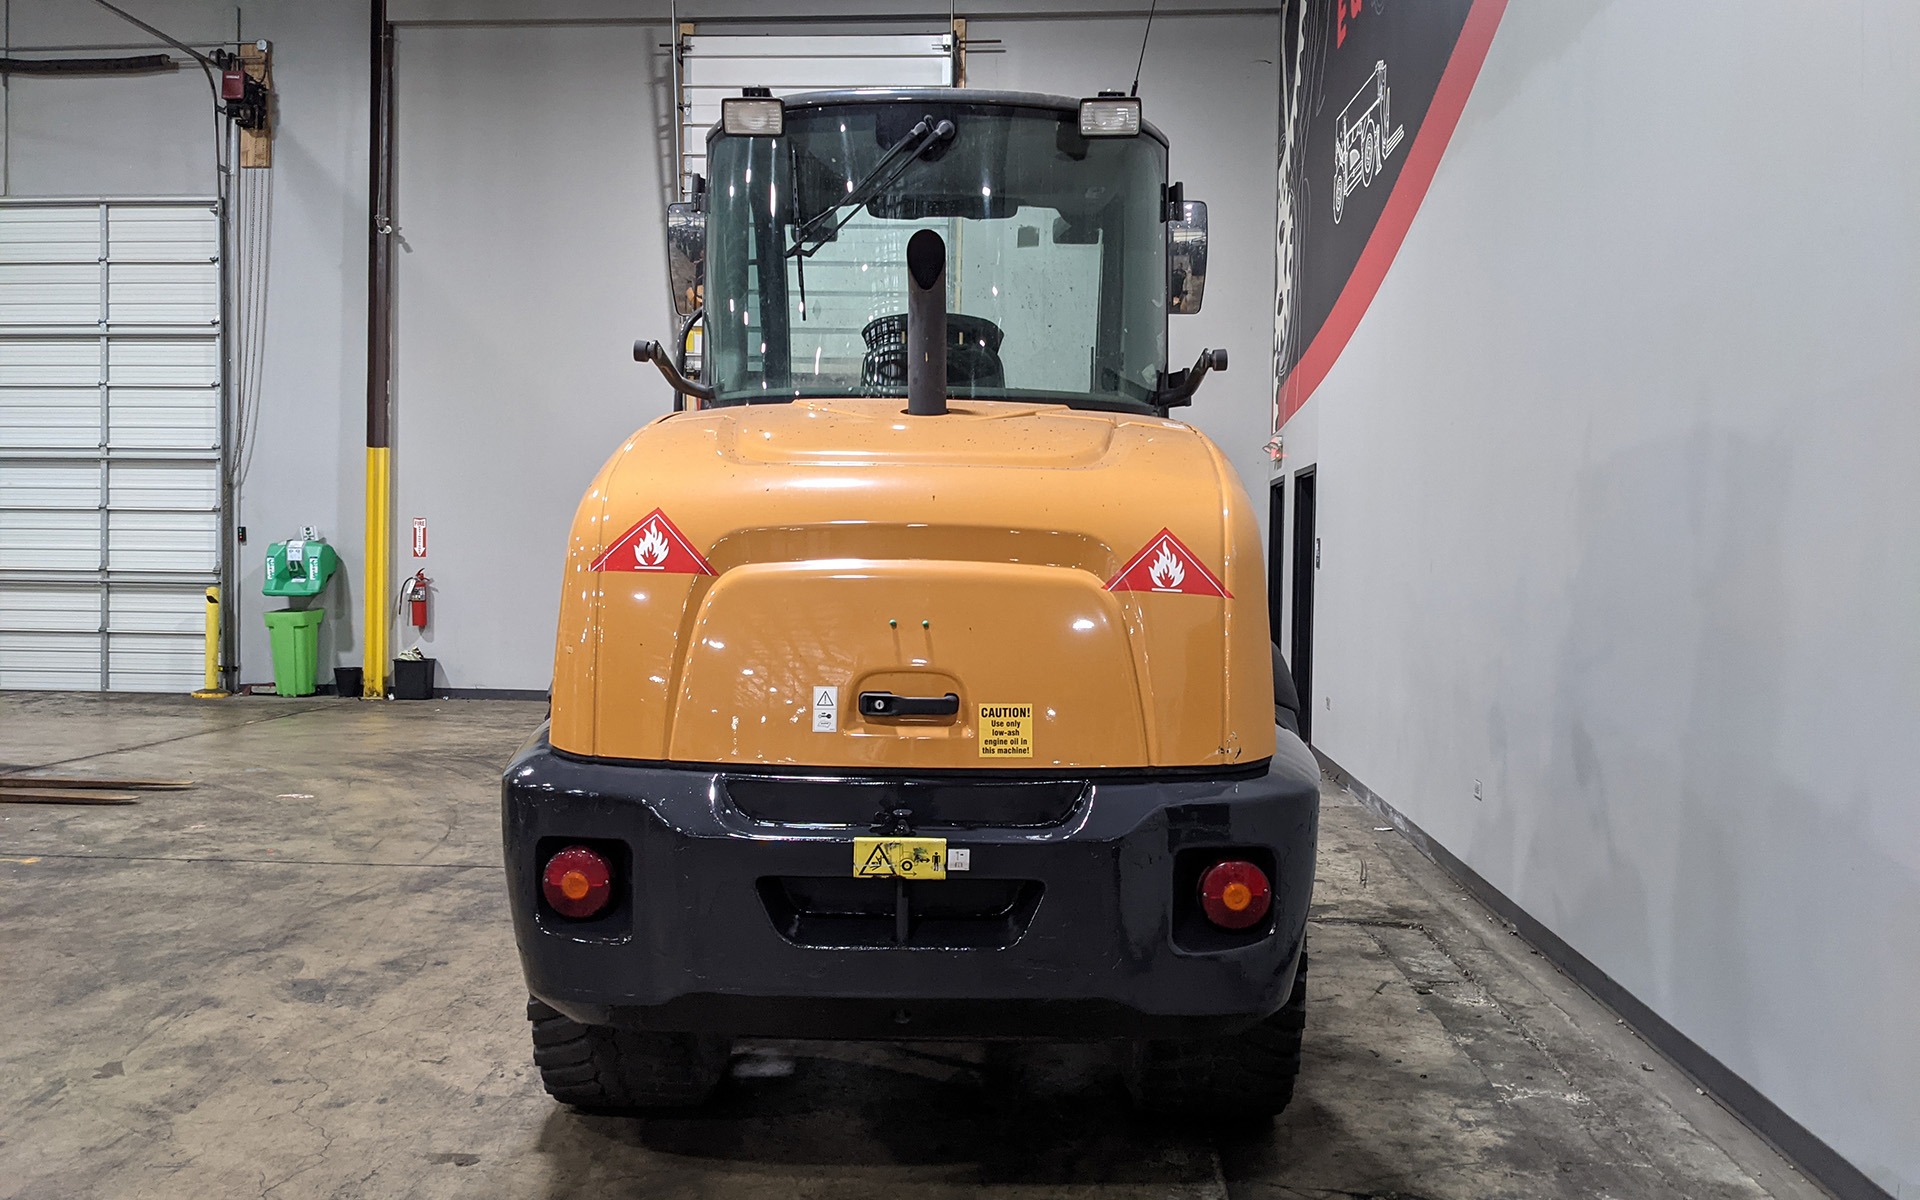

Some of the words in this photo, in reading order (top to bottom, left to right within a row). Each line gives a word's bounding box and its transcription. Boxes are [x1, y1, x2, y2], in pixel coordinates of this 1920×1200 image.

[981, 707, 1031, 718] CAUTION!
[1006, 720, 1021, 729] only
[984, 738, 1008, 746] engine
